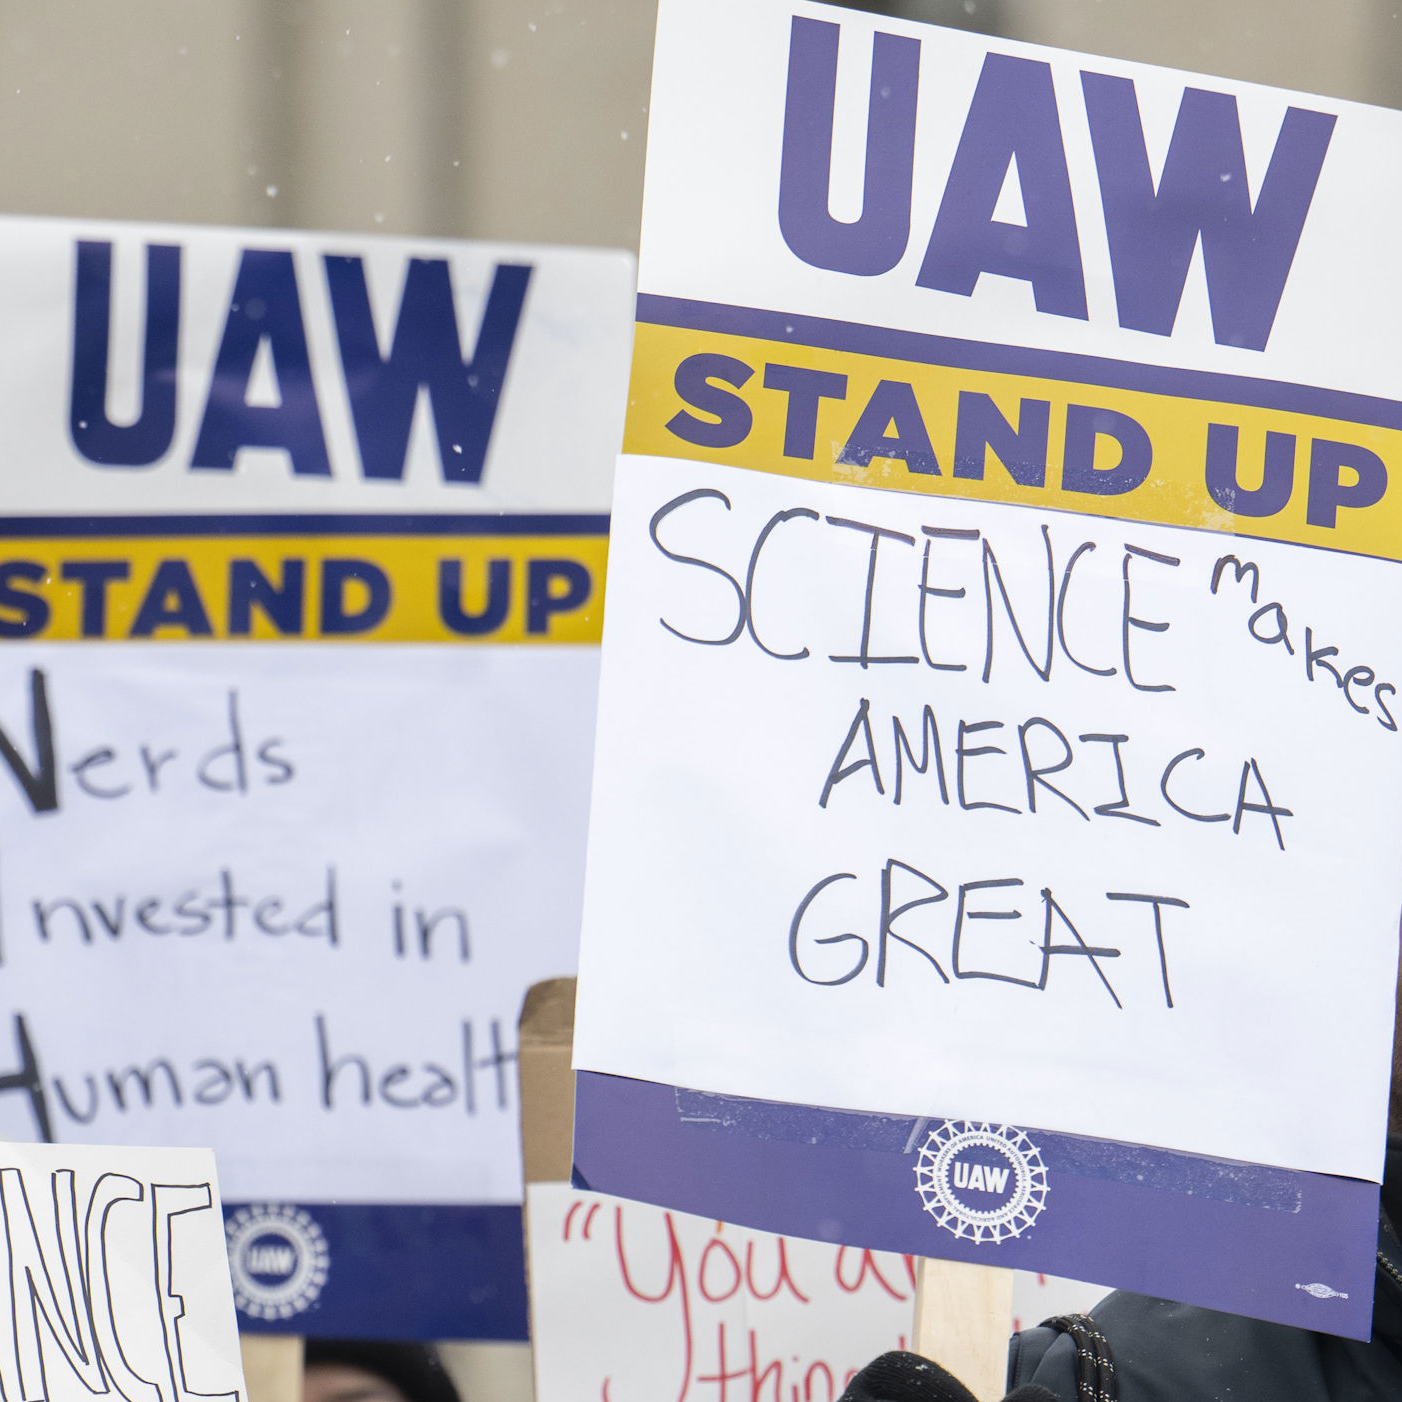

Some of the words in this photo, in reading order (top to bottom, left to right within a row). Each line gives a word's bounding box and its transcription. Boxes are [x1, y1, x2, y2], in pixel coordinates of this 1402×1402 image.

[777, 14, 1338, 353] UAW
[68, 240, 534, 485] UAW
[664, 353, 1153, 496] STAND
[1204, 422, 1388, 528] UP
[438, 558, 592, 637] UP
[649, 488, 1180, 692] SCIENCE
[818, 697, 1294, 852] AMERICA
[392, 880, 471, 963] in
[788, 858, 1191, 1010] GREAT
[951, 1160, 1011, 1195] UAW
